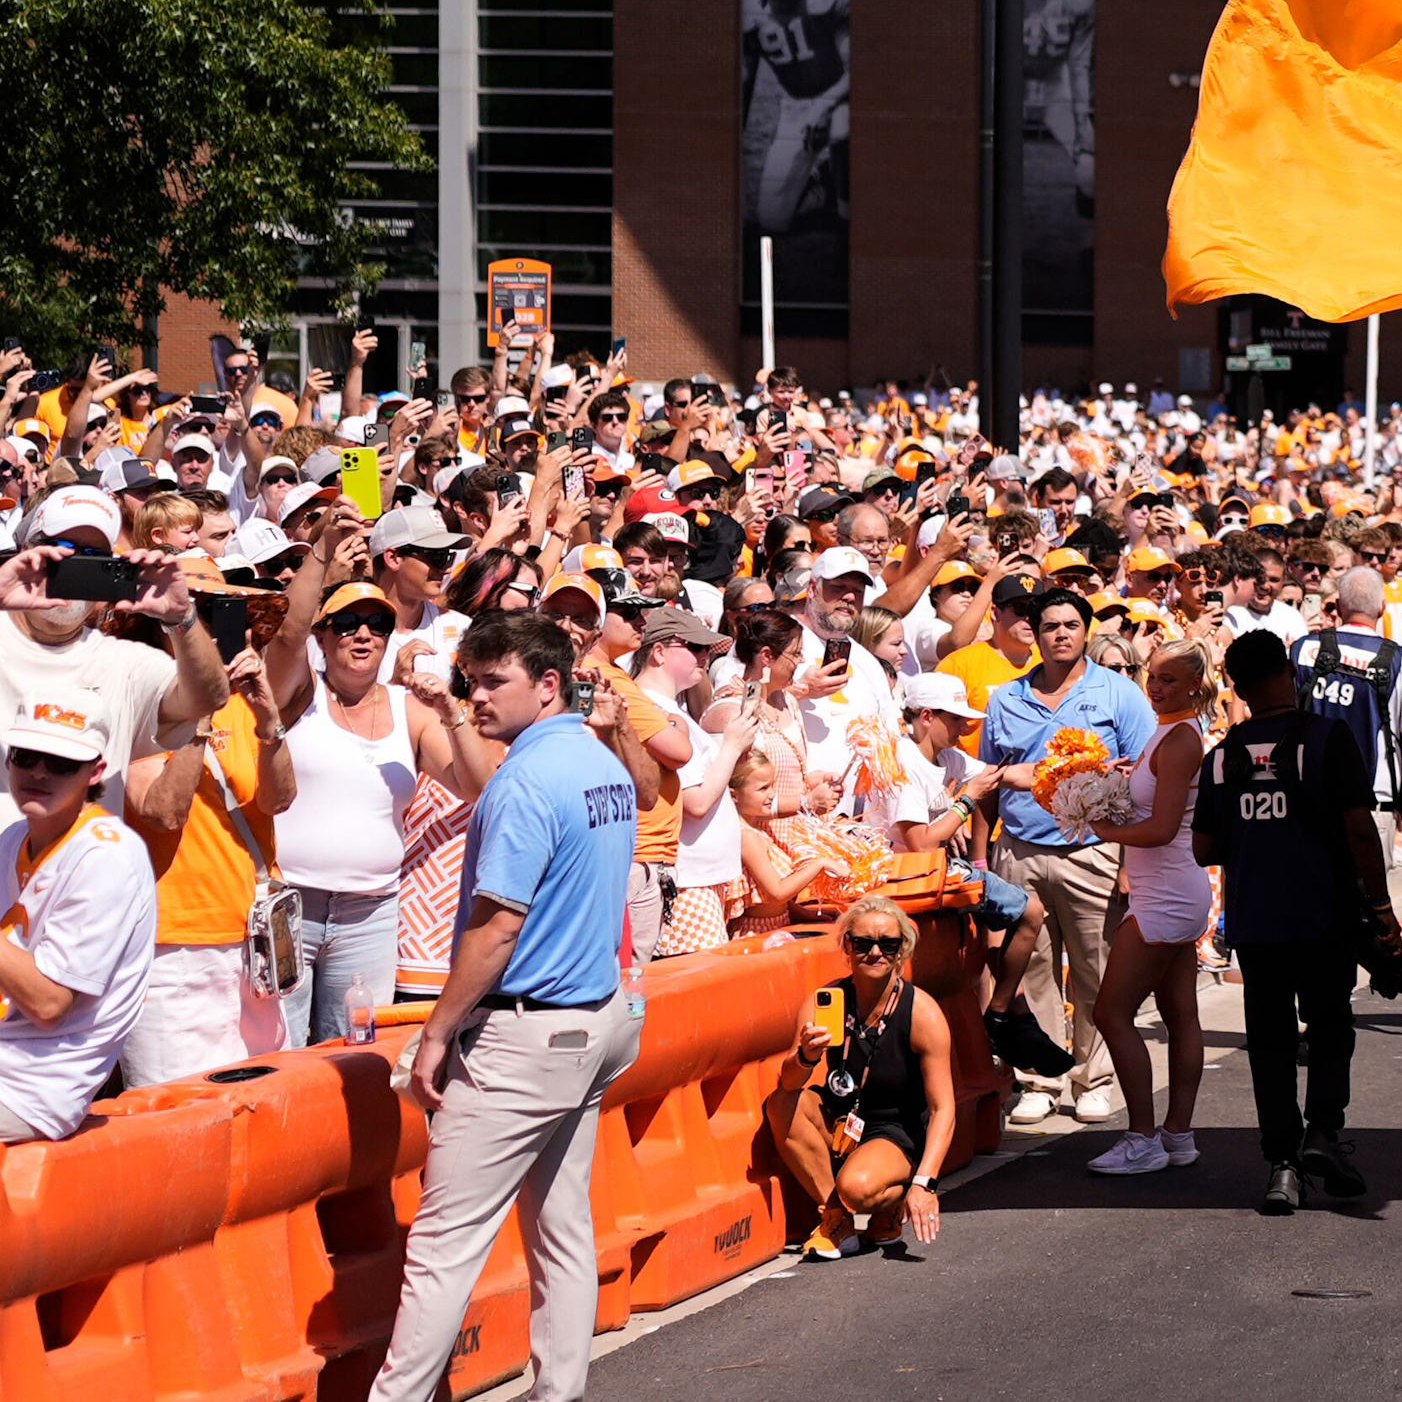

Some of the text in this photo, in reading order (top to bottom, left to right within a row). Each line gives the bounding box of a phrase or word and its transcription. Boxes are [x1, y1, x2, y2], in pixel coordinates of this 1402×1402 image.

[757, 16, 815, 65] 91
[1312, 676, 1355, 707] 049
[1240, 791, 1288, 820] 020
